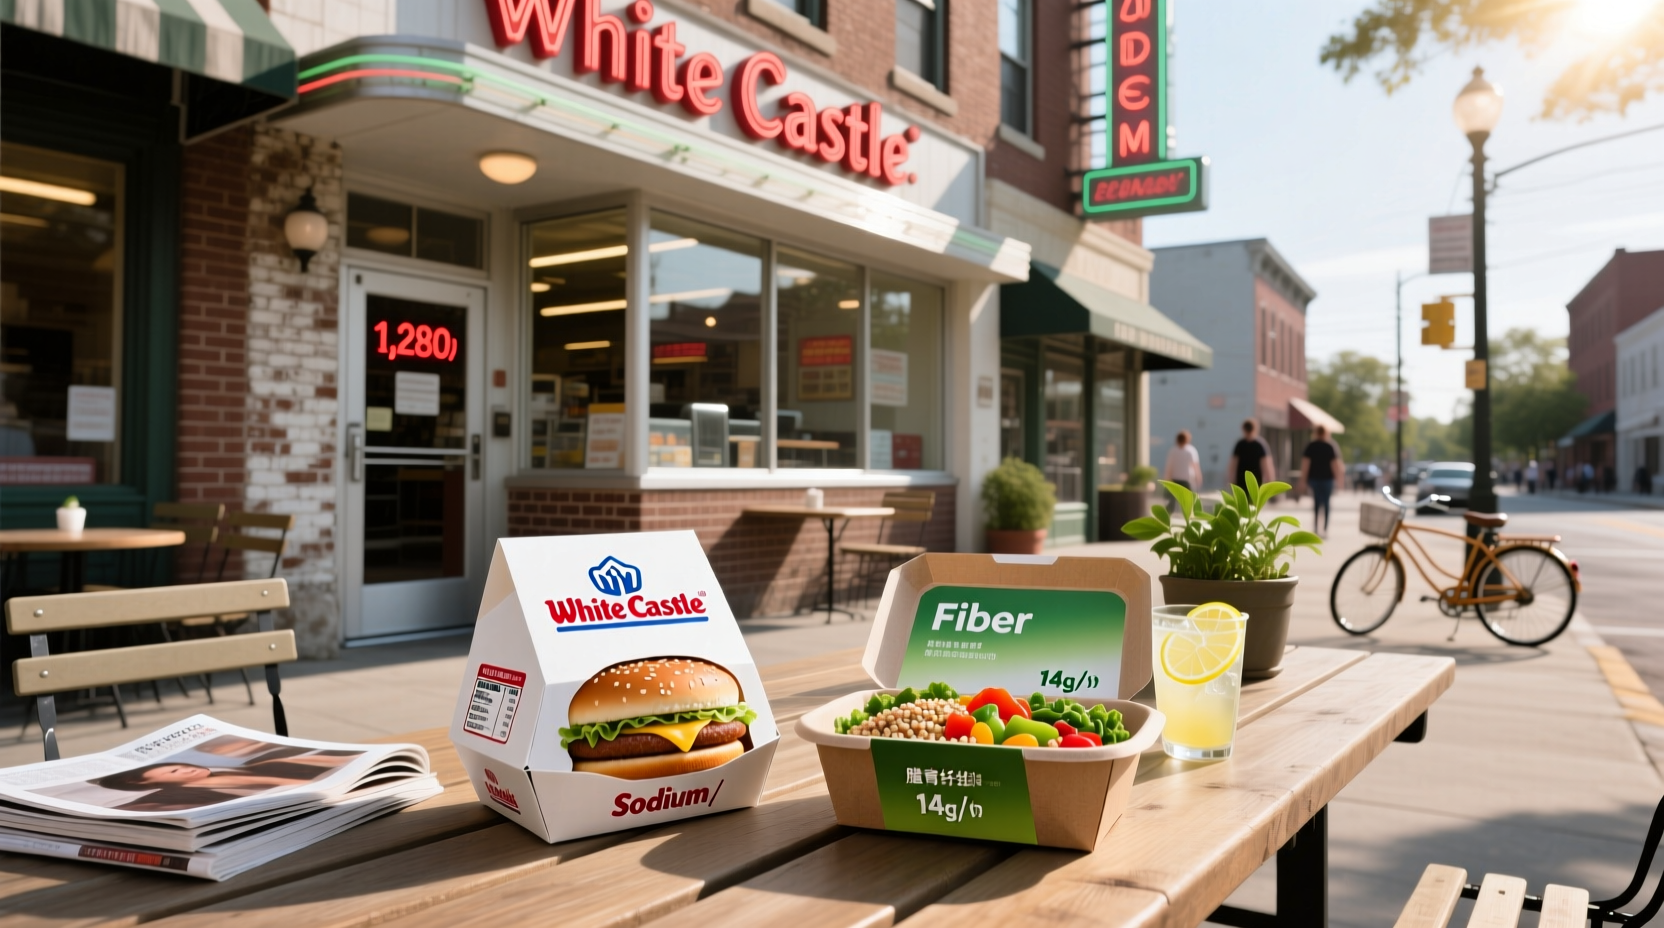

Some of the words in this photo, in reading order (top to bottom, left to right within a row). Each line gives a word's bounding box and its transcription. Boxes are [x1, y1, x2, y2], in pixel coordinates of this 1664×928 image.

[486, 0, 724, 116] White
[544, 597, 627, 624] White
[627, 592, 706, 618] Castle
[931, 602, 1034, 634] Fiber
